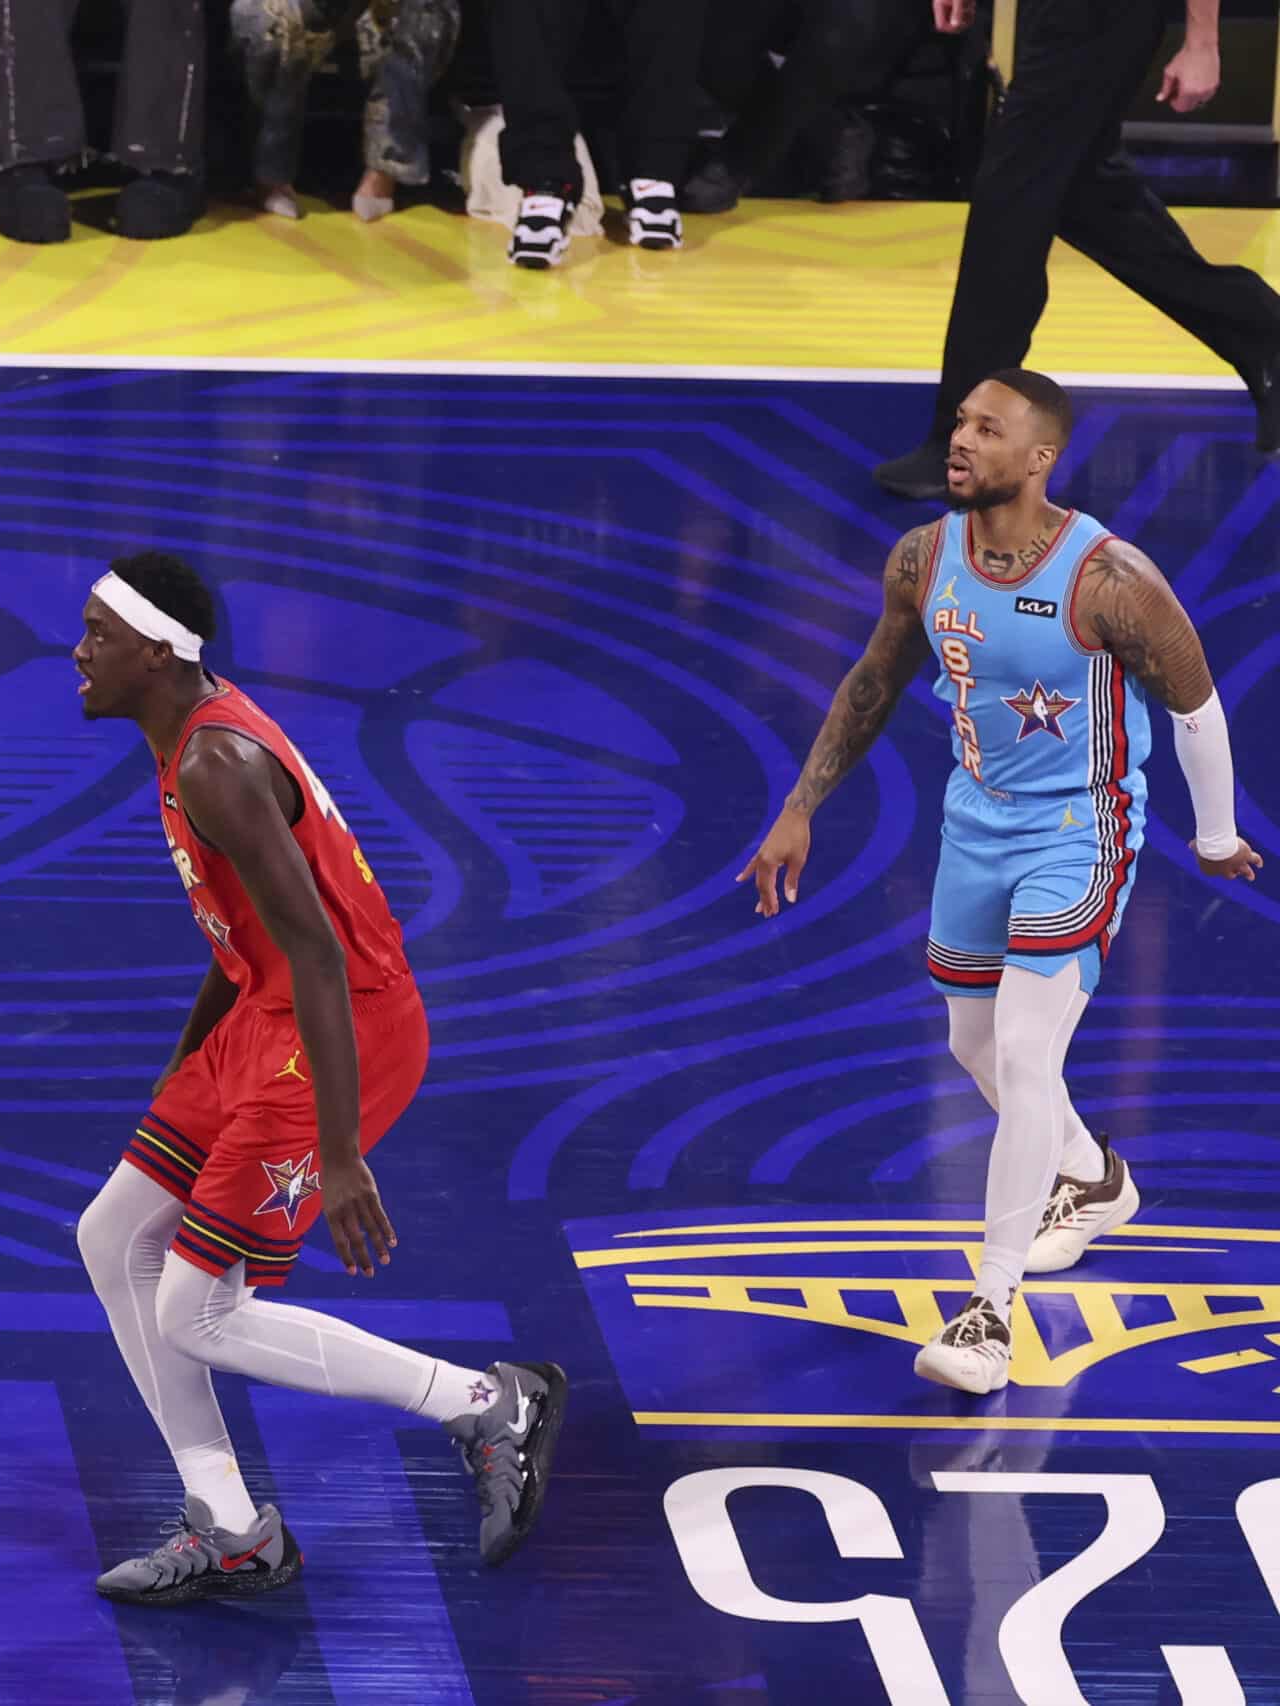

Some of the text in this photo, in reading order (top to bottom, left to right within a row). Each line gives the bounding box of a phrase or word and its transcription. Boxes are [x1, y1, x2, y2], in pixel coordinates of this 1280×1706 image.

[1018, 600, 1054, 614] KIA
[933, 608, 985, 642] ALL
[940, 637, 984, 783] STAR
